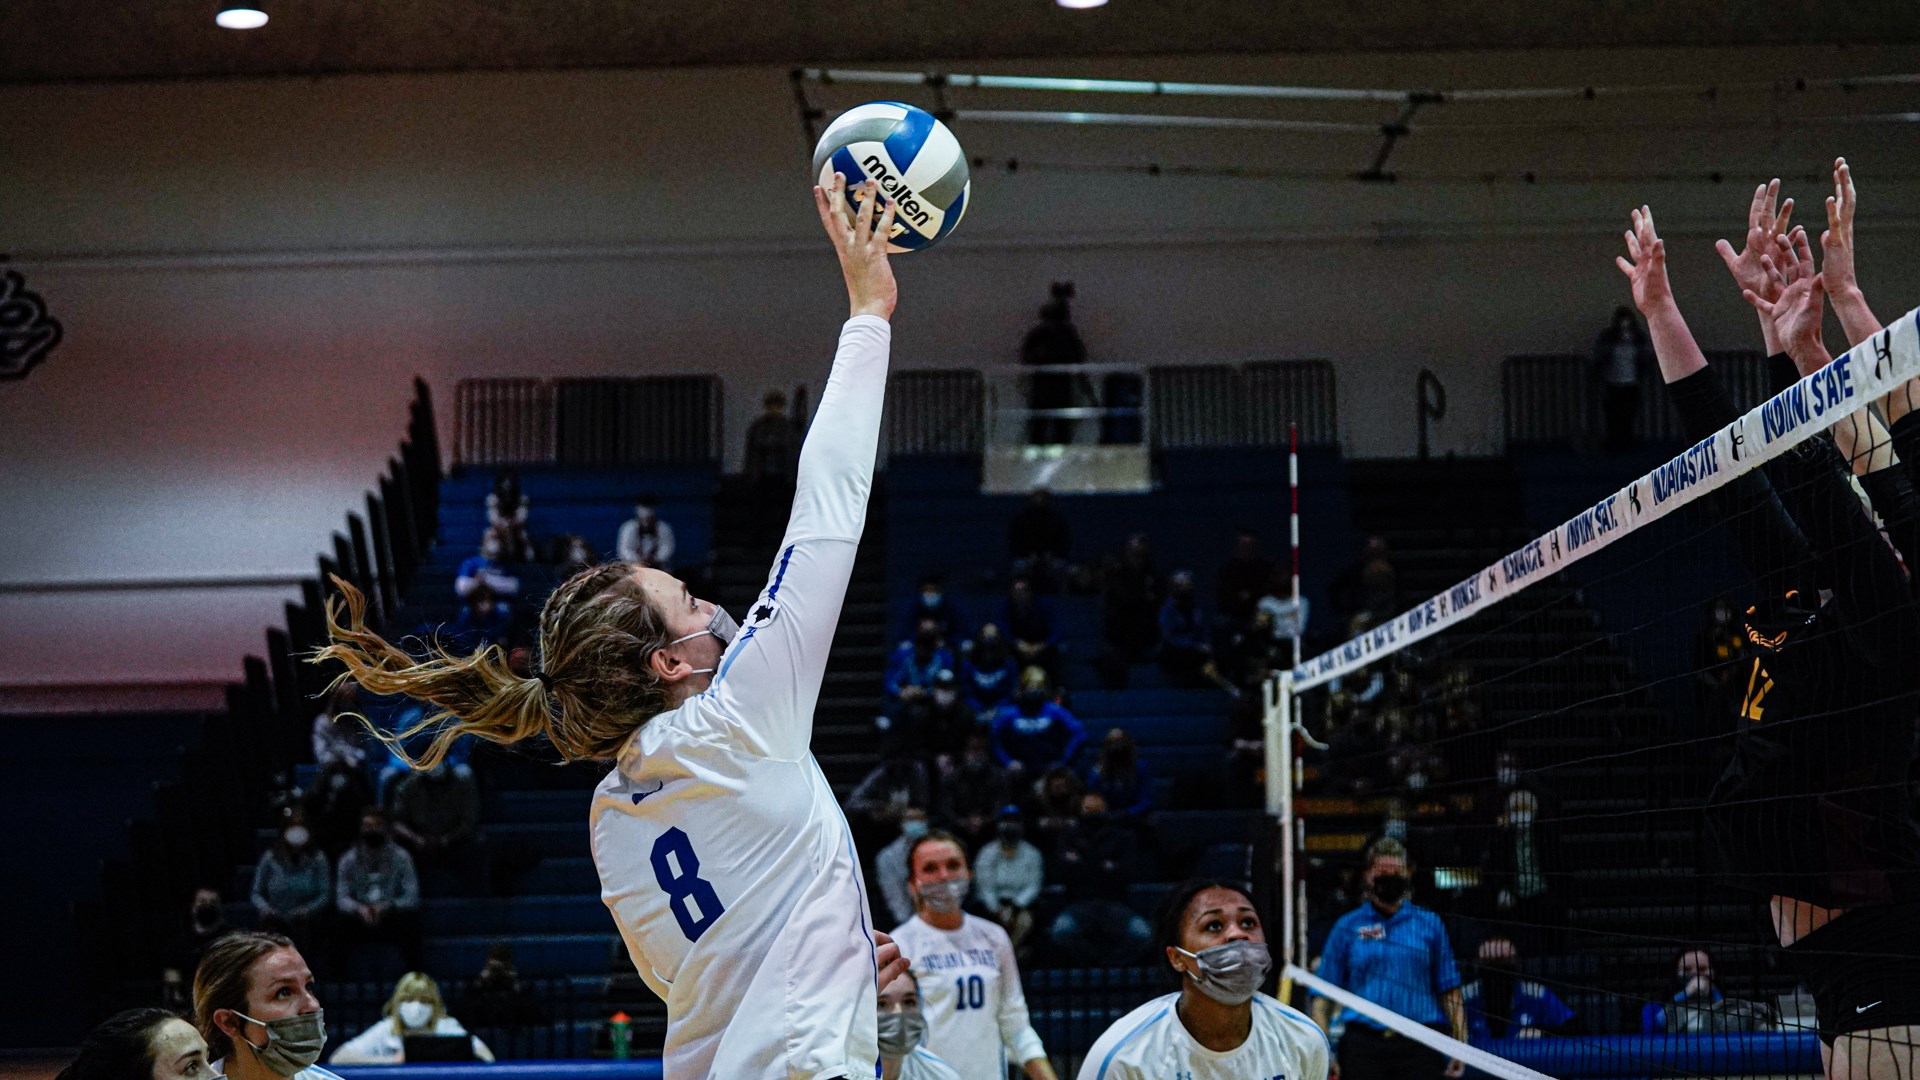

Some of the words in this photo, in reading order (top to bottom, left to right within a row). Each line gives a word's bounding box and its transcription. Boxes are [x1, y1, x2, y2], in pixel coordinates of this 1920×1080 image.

[862, 155, 929, 227] molten
[1741, 657, 1774, 721] 12
[650, 826, 726, 943] 8
[955, 974, 985, 1011] 10
